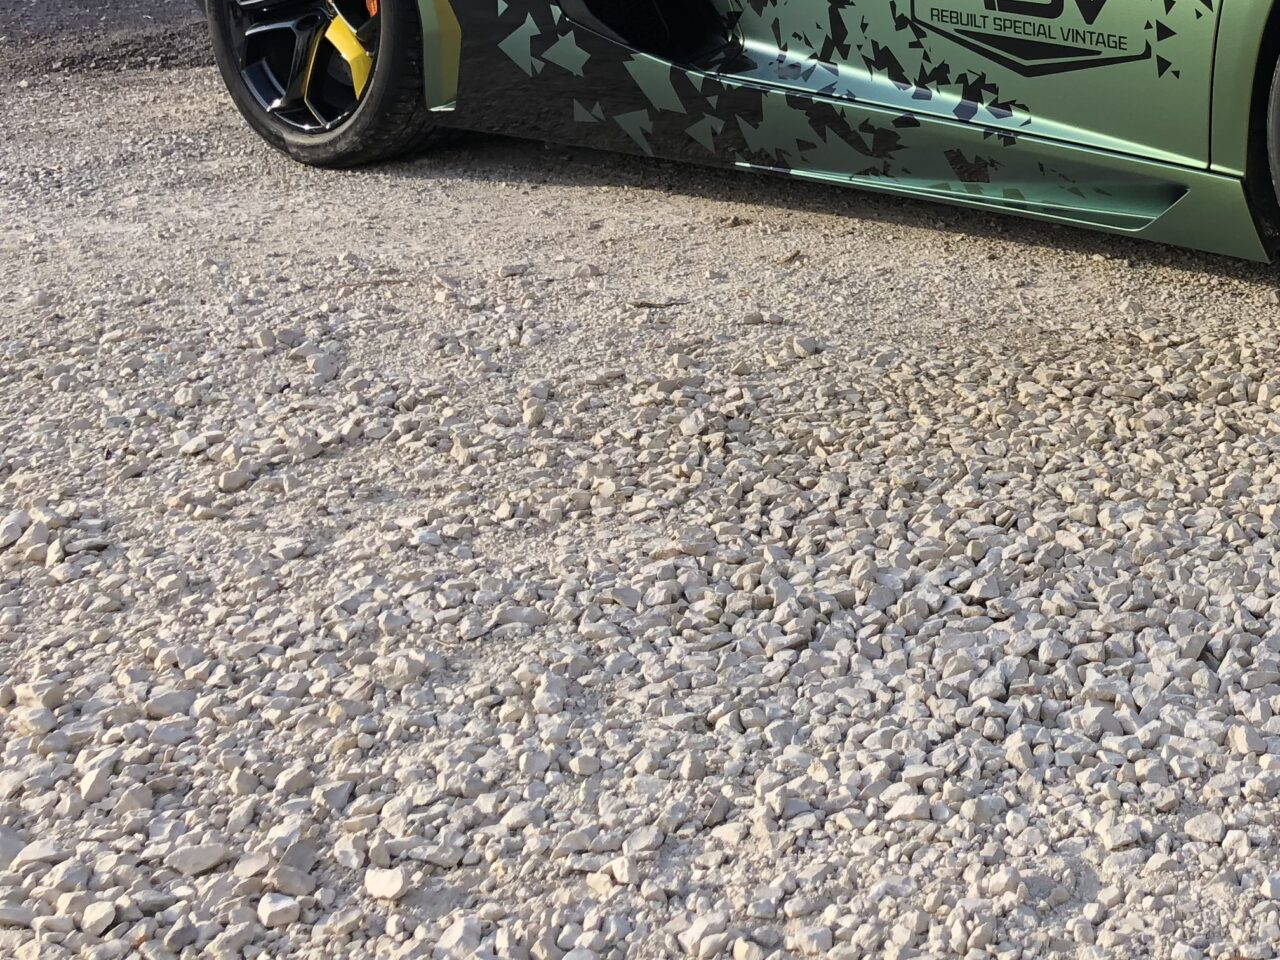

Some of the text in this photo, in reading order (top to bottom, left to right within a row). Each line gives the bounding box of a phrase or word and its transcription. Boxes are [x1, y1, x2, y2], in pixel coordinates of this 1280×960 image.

[930, 7, 1128, 51] REBUILT SPECIAL VINTAGE
